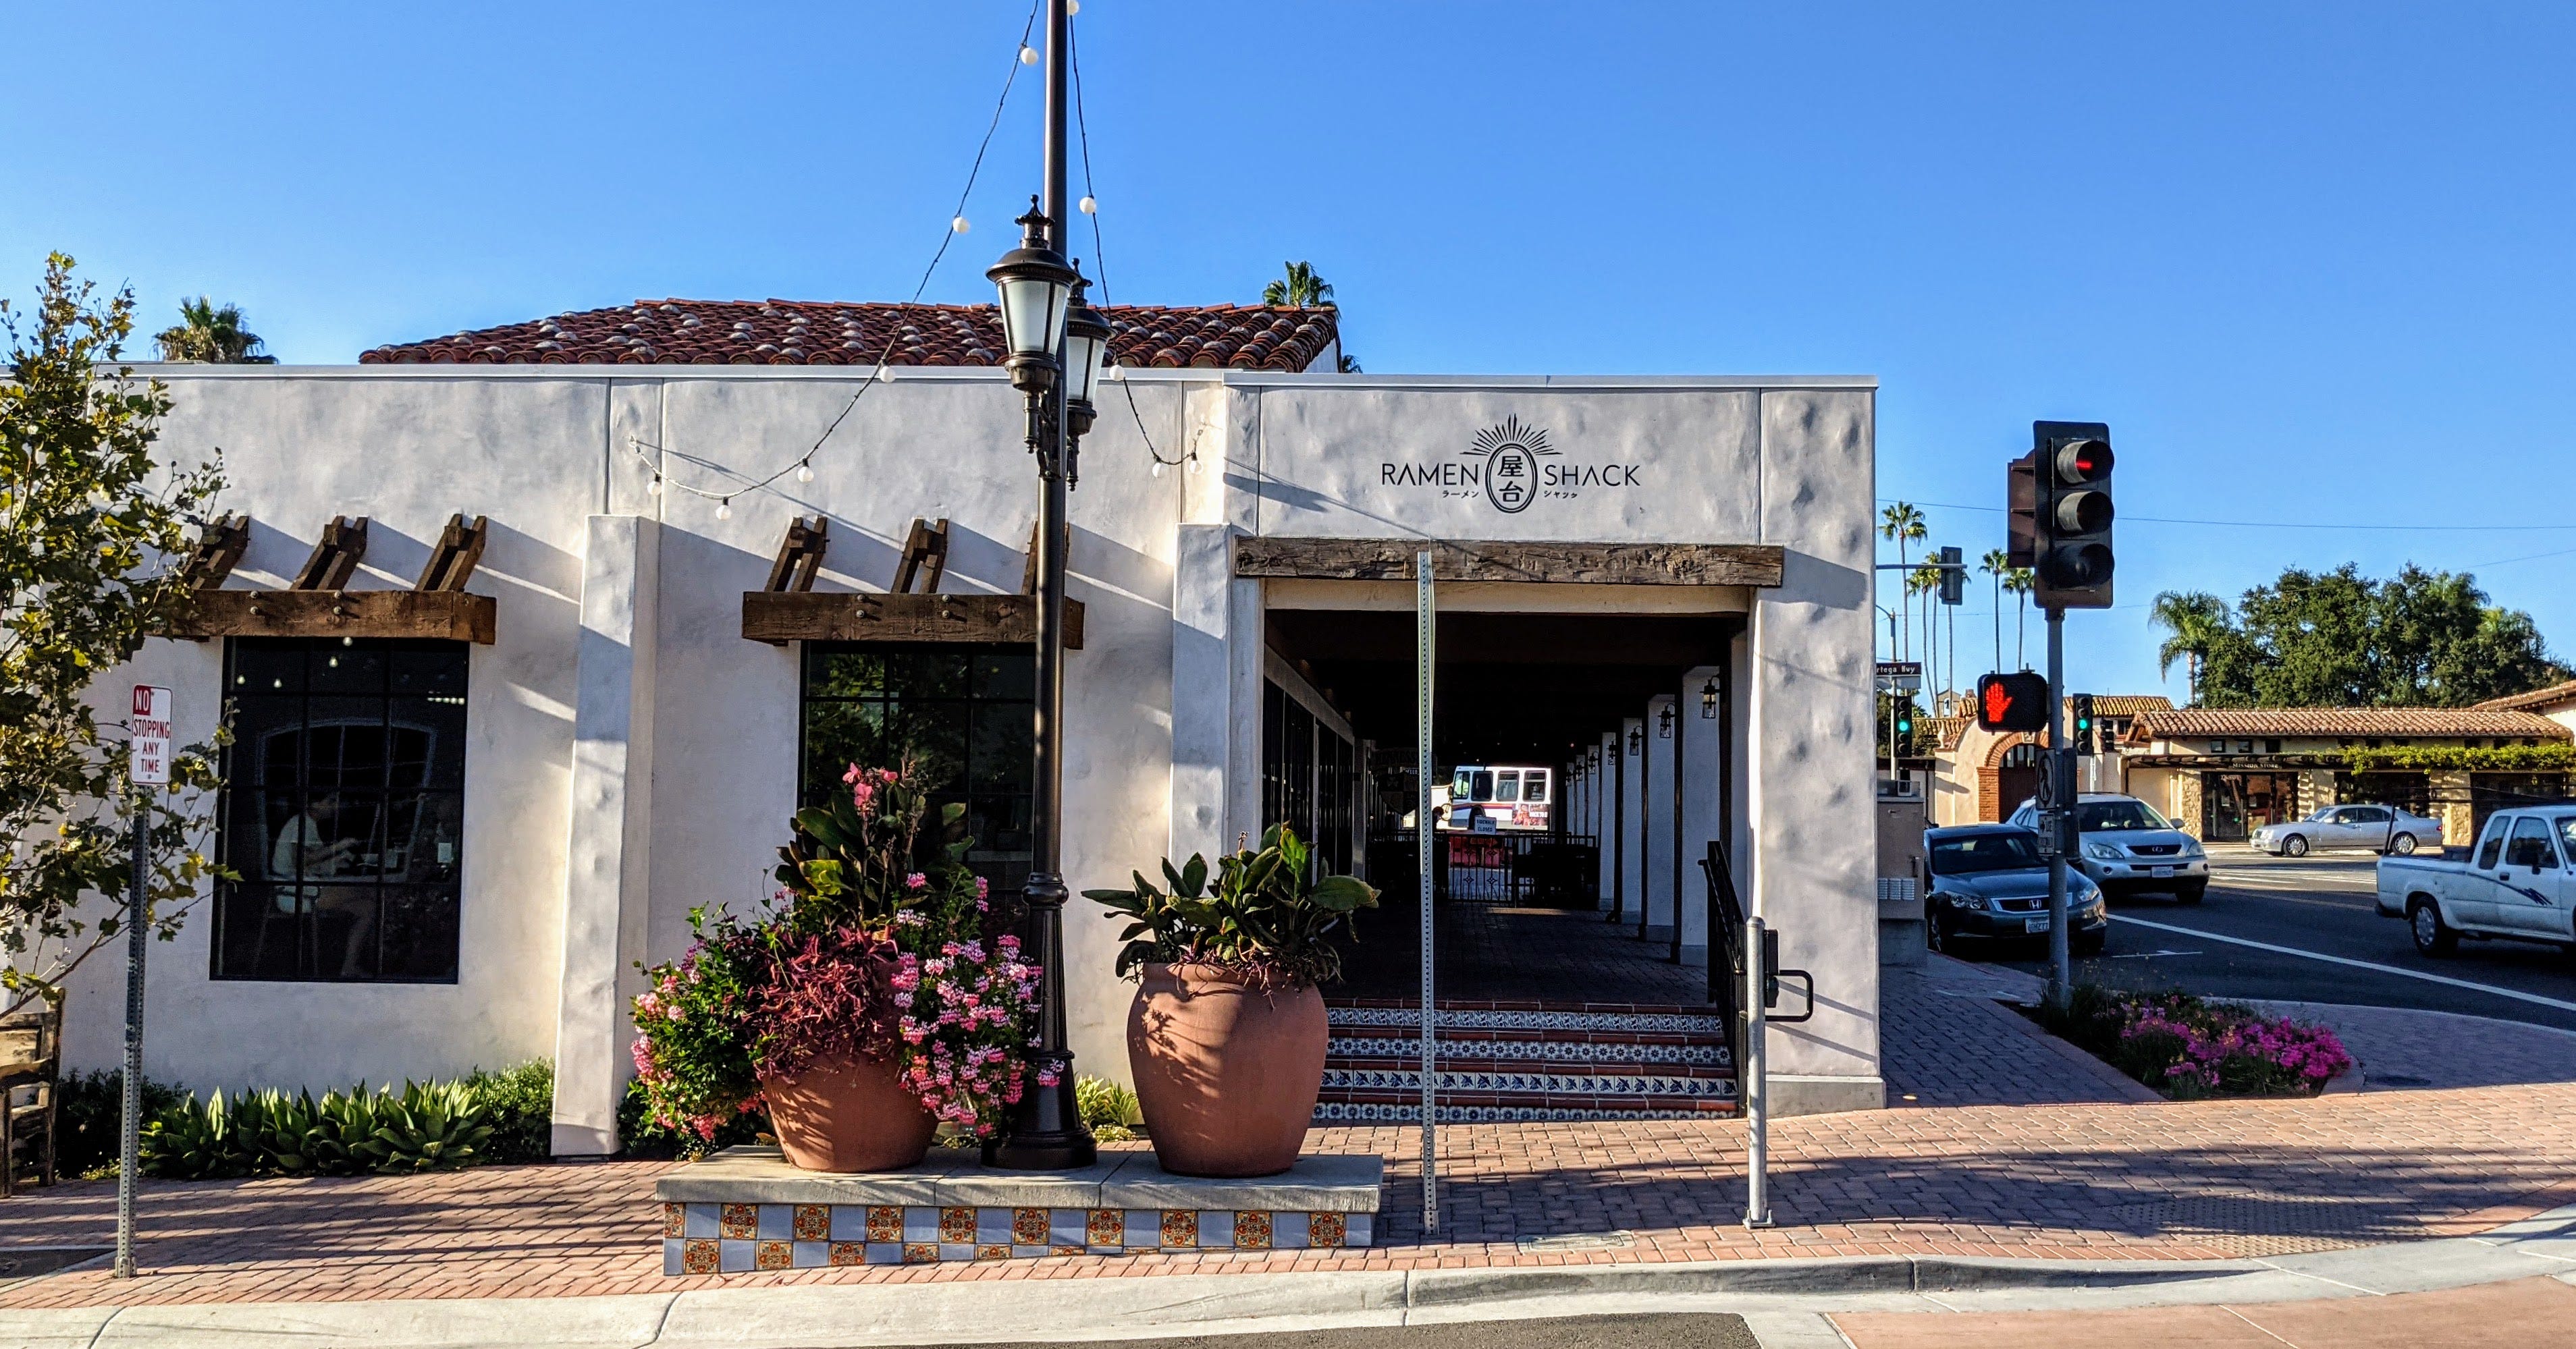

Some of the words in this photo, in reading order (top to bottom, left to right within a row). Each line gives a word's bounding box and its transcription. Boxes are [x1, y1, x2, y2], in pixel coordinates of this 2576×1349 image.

[1382, 462, 1478, 486] RAMEN
[1544, 464, 1640, 486] SHACK
[1877, 665, 1897, 674] rtega
[136, 690, 149, 711] NO
[134, 719, 169, 739] STOPPING
[142, 742, 159, 756] ANY
[141, 759, 159, 773] TIME
